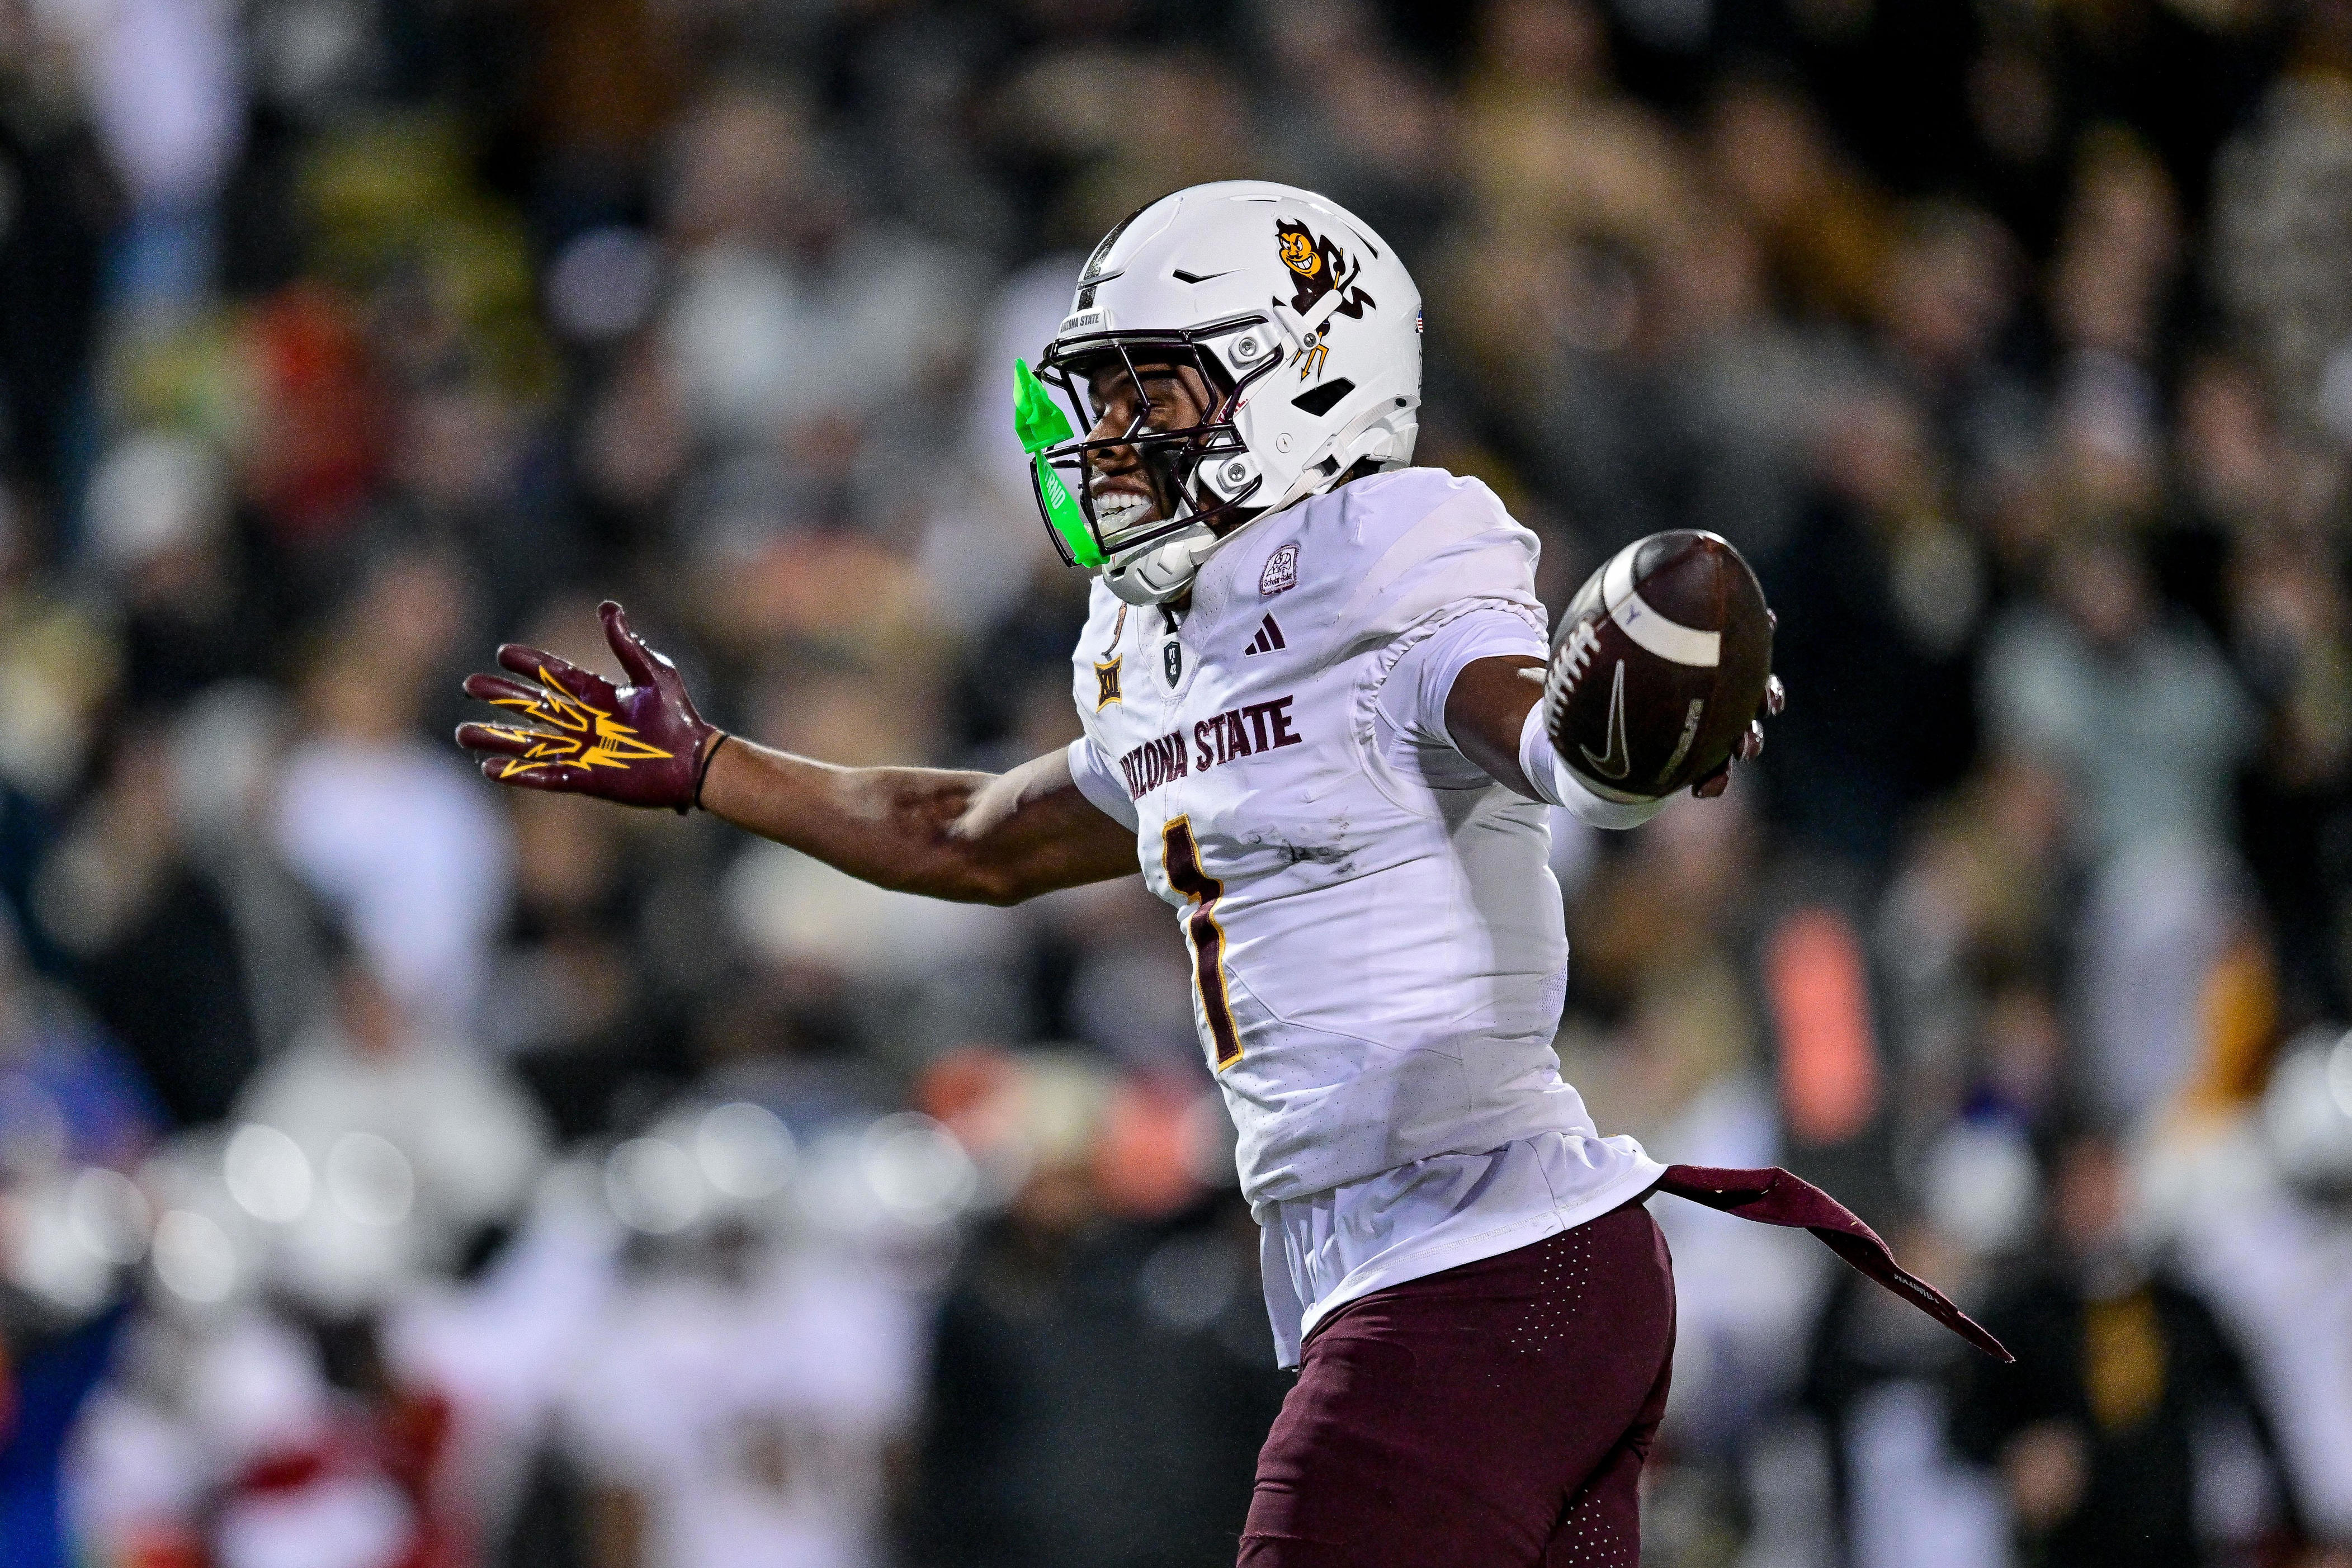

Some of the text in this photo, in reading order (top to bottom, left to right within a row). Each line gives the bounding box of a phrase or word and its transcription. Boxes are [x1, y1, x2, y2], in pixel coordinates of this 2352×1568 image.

[1080, 313, 1101, 326] STATE
[1169, 664, 1177, 676] 42
[1118, 695, 1302, 802] RIZONA STATE
[1161, 813, 1244, 1073] 1
